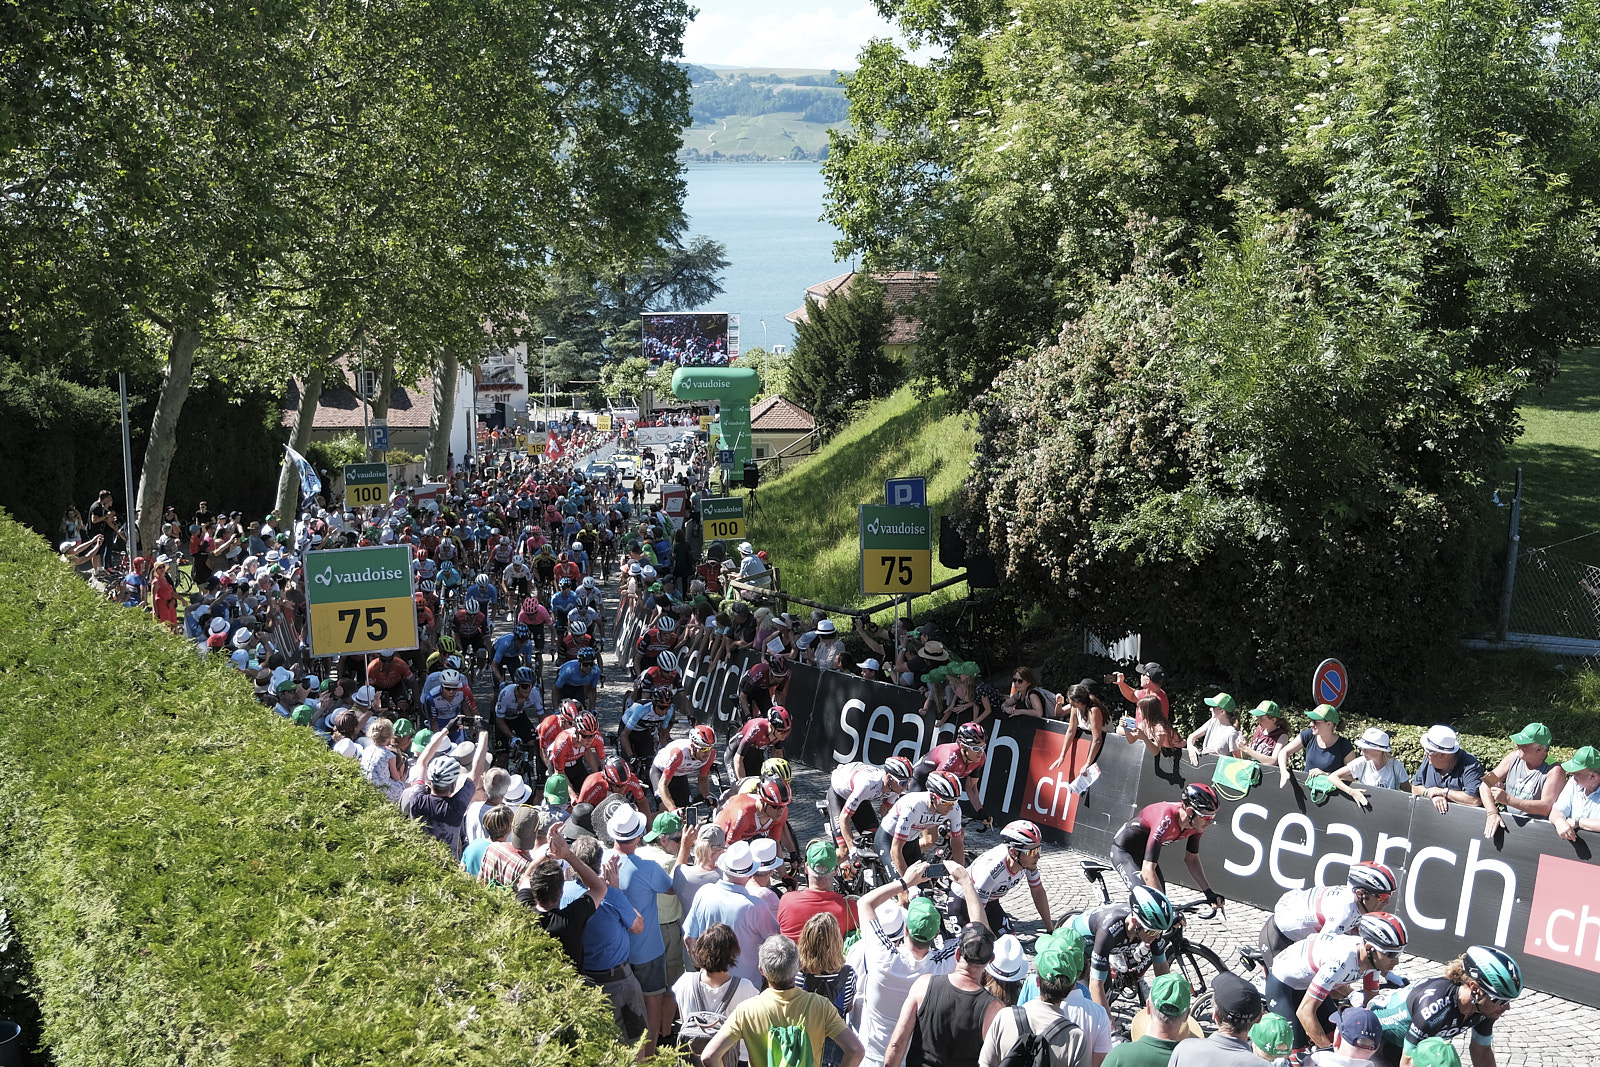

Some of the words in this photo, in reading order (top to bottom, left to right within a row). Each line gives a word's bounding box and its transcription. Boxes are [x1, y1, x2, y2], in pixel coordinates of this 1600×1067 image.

[693, 379, 731, 388] vaudoise
[373, 429, 384, 443] P
[532, 445, 546, 453] 150
[722, 452, 729, 462] P
[353, 486, 382, 502] 100
[894, 484, 913, 505] P
[714, 505, 742, 514] vaudoise
[710, 521, 738, 537] 100
[880, 519, 926, 535] vaudoise
[333, 566, 403, 585] vaudoise
[880, 556, 913, 586] 75
[338, 606, 388, 644] 75
[745, 725, 760, 742] INEOS
[833, 698, 1020, 814] searh
[1026, 771, 1072, 820] .ch
[943, 752, 958, 771] INEOS
[920, 814, 945, 825] UAE
[1153, 814, 1173, 841] INEOS
[990, 861, 1004, 876] BORA
[1116, 863, 1133, 889] INEOS
[1223, 801, 1518, 948] search
[977, 888, 990, 896] ORA
[1108, 919, 1124, 934] BORA
[1420, 996, 1452, 1021] BORA
[1410, 1022, 1429, 1038] BORA
